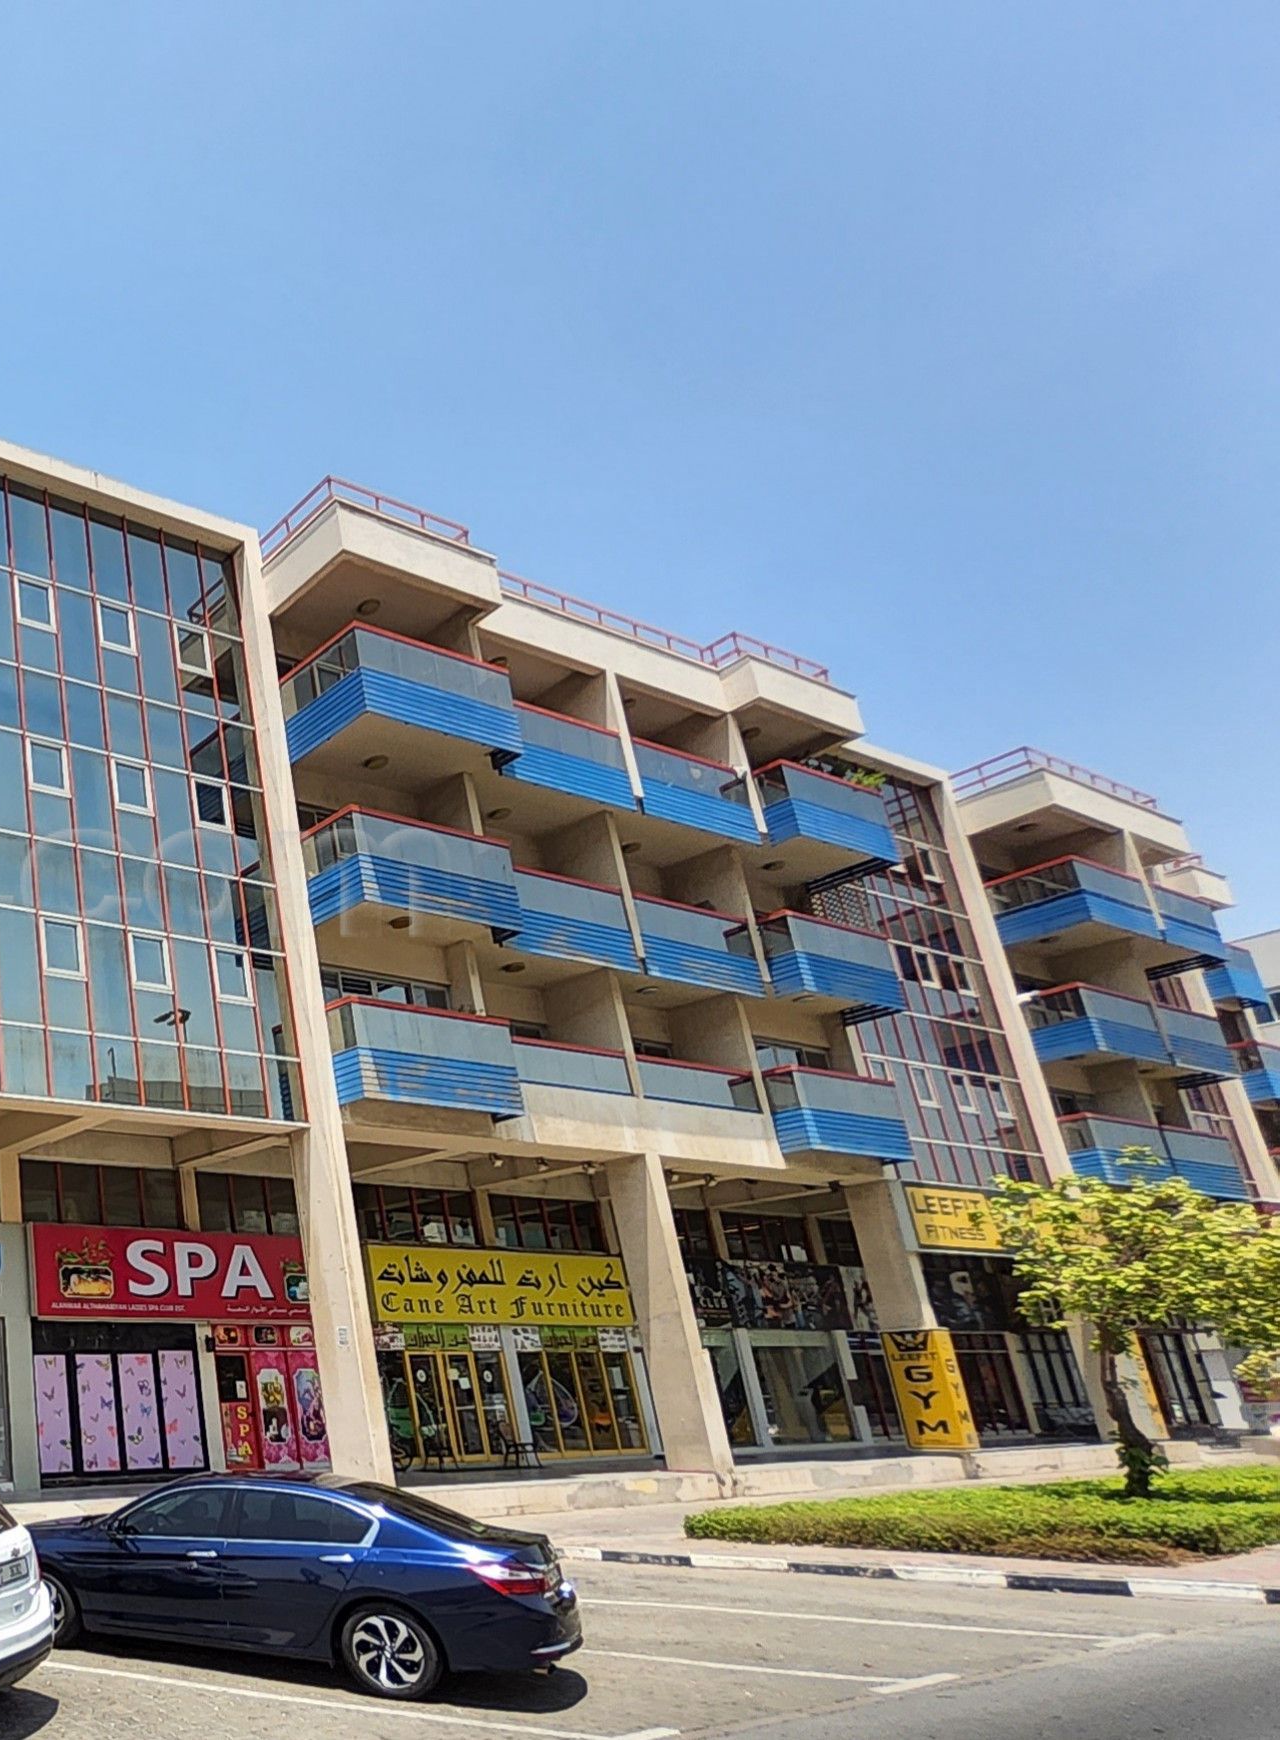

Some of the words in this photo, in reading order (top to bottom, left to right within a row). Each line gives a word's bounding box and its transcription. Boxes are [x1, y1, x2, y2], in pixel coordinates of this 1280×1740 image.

[911, 1191, 980, 1218] LEEFIT
[925, 1224, 987, 1241] FITNESS
[126, 1239, 275, 1299] SPA
[377, 1254, 506, 1294] للمفروشات
[381, 1291, 445, 1314] Cane
[456, 1293, 499, 1316] Art
[509, 1295, 625, 1319] Furniture
[904, 1365, 951, 1436] GYM
